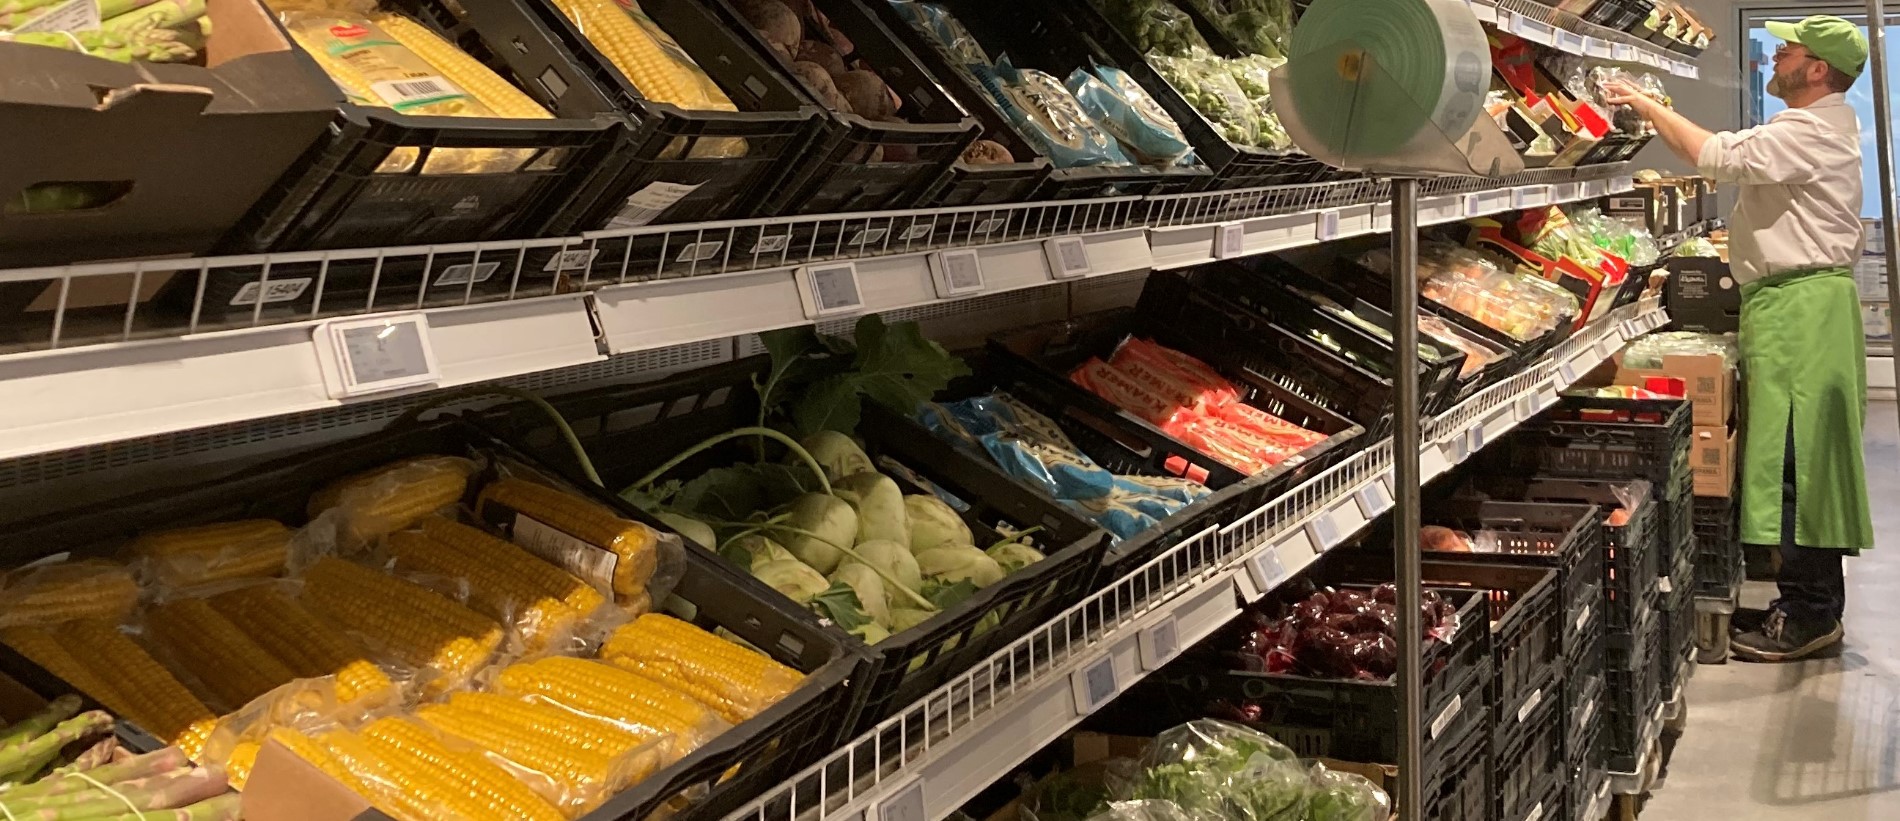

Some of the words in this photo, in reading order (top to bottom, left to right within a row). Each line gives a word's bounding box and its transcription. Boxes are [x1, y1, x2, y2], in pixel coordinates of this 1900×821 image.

[1096, 367, 1168, 413] KRAMER
[1128, 364, 1199, 410] KRAMER
[1213, 419, 1290, 453] KRAMER
